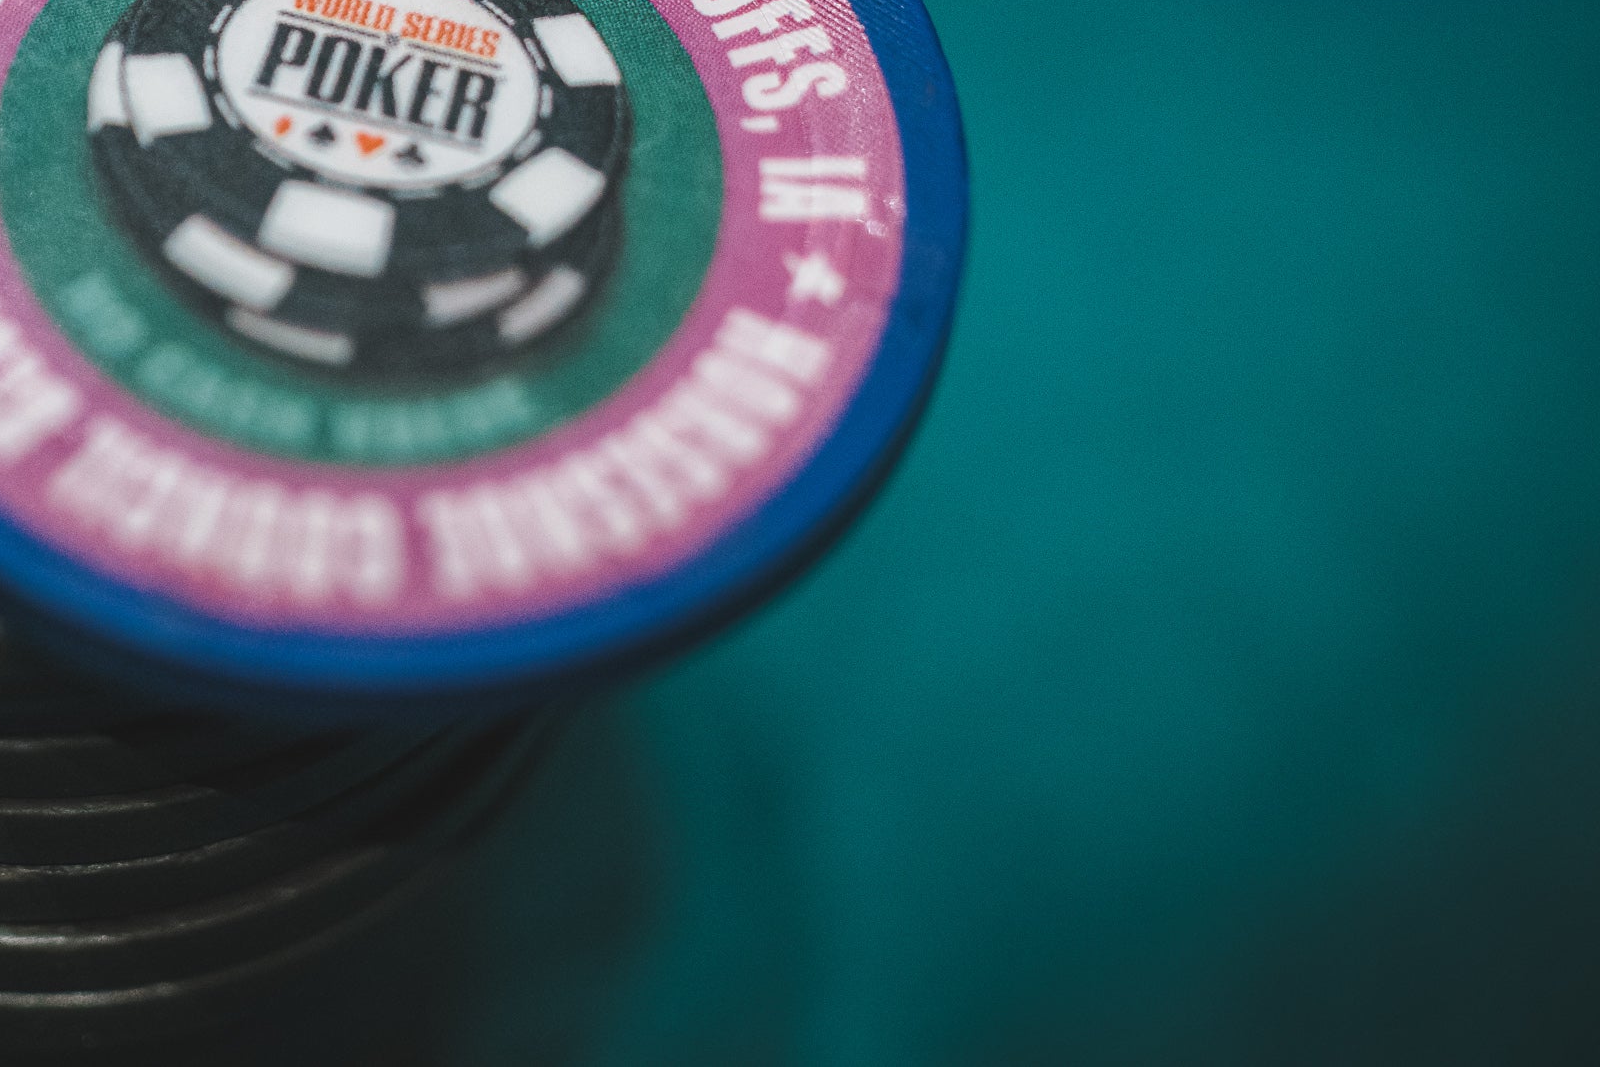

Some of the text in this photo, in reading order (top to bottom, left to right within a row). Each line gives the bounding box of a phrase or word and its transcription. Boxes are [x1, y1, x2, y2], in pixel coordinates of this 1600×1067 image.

[401, 11, 500, 58] SERIES
[256, 22, 496, 139] POKER
[760, 155, 868, 222] IA
